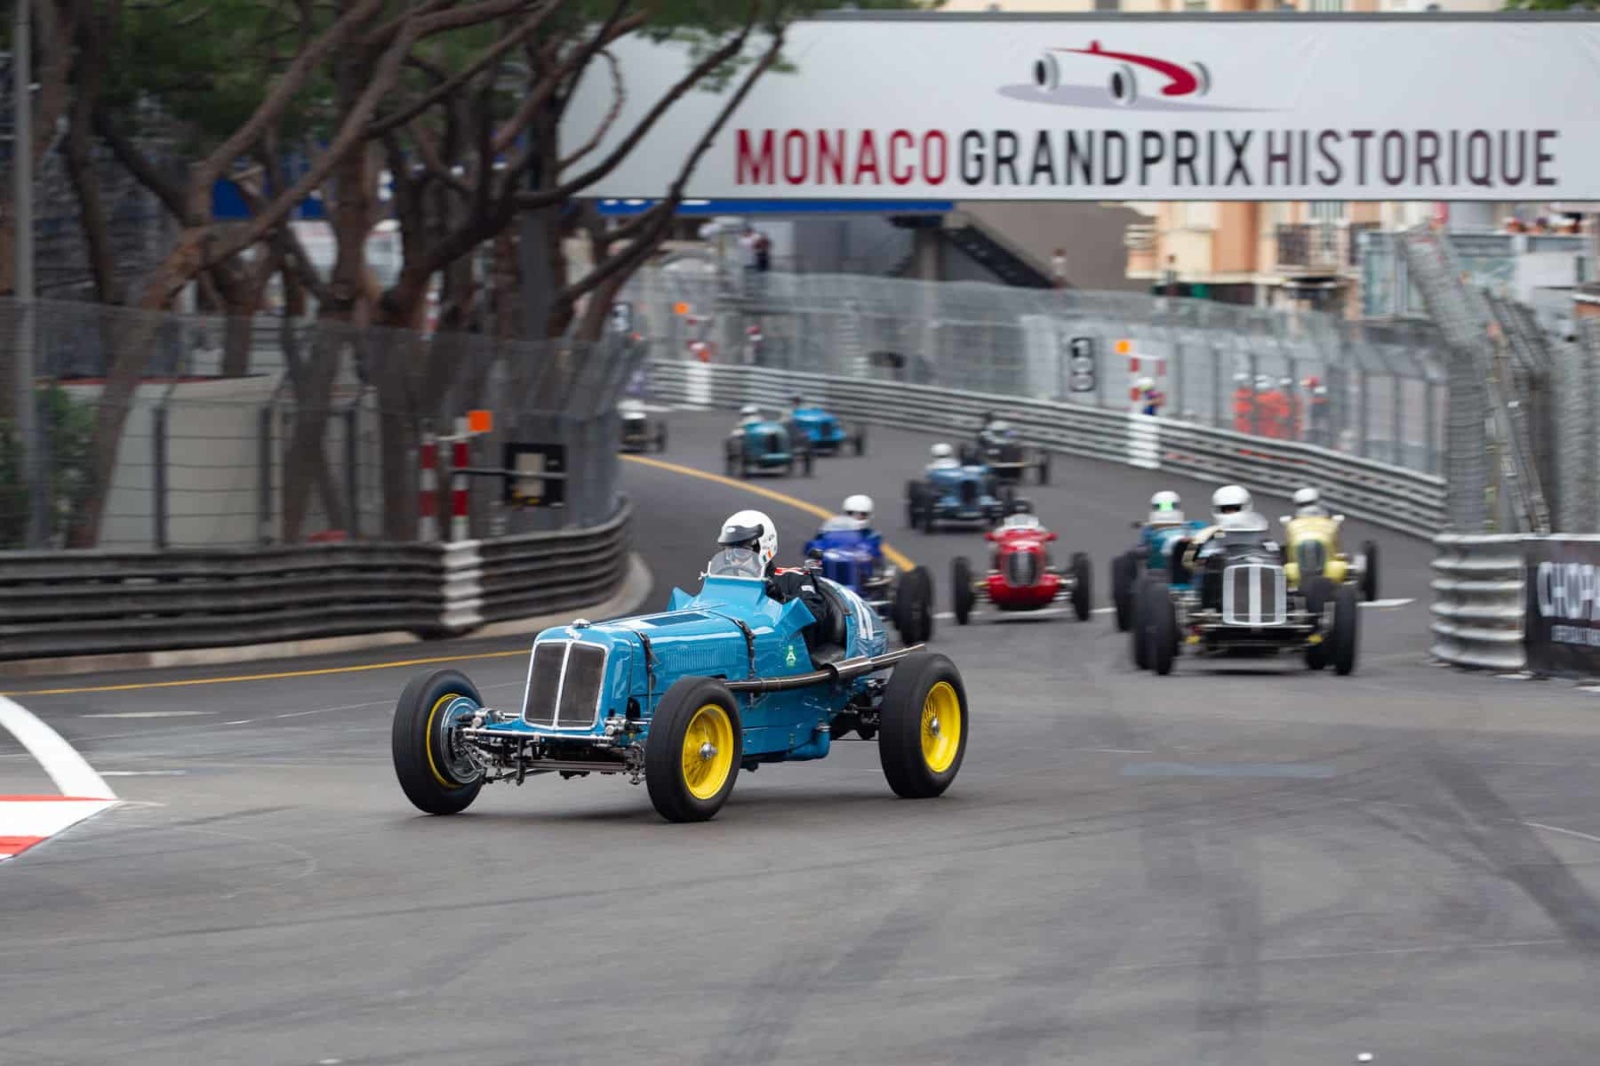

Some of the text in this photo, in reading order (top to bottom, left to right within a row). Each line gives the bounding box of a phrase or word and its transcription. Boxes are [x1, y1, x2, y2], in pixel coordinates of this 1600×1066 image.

[734, 128, 1559, 188] MONACO GRAND PRIX HISTORIQUE
